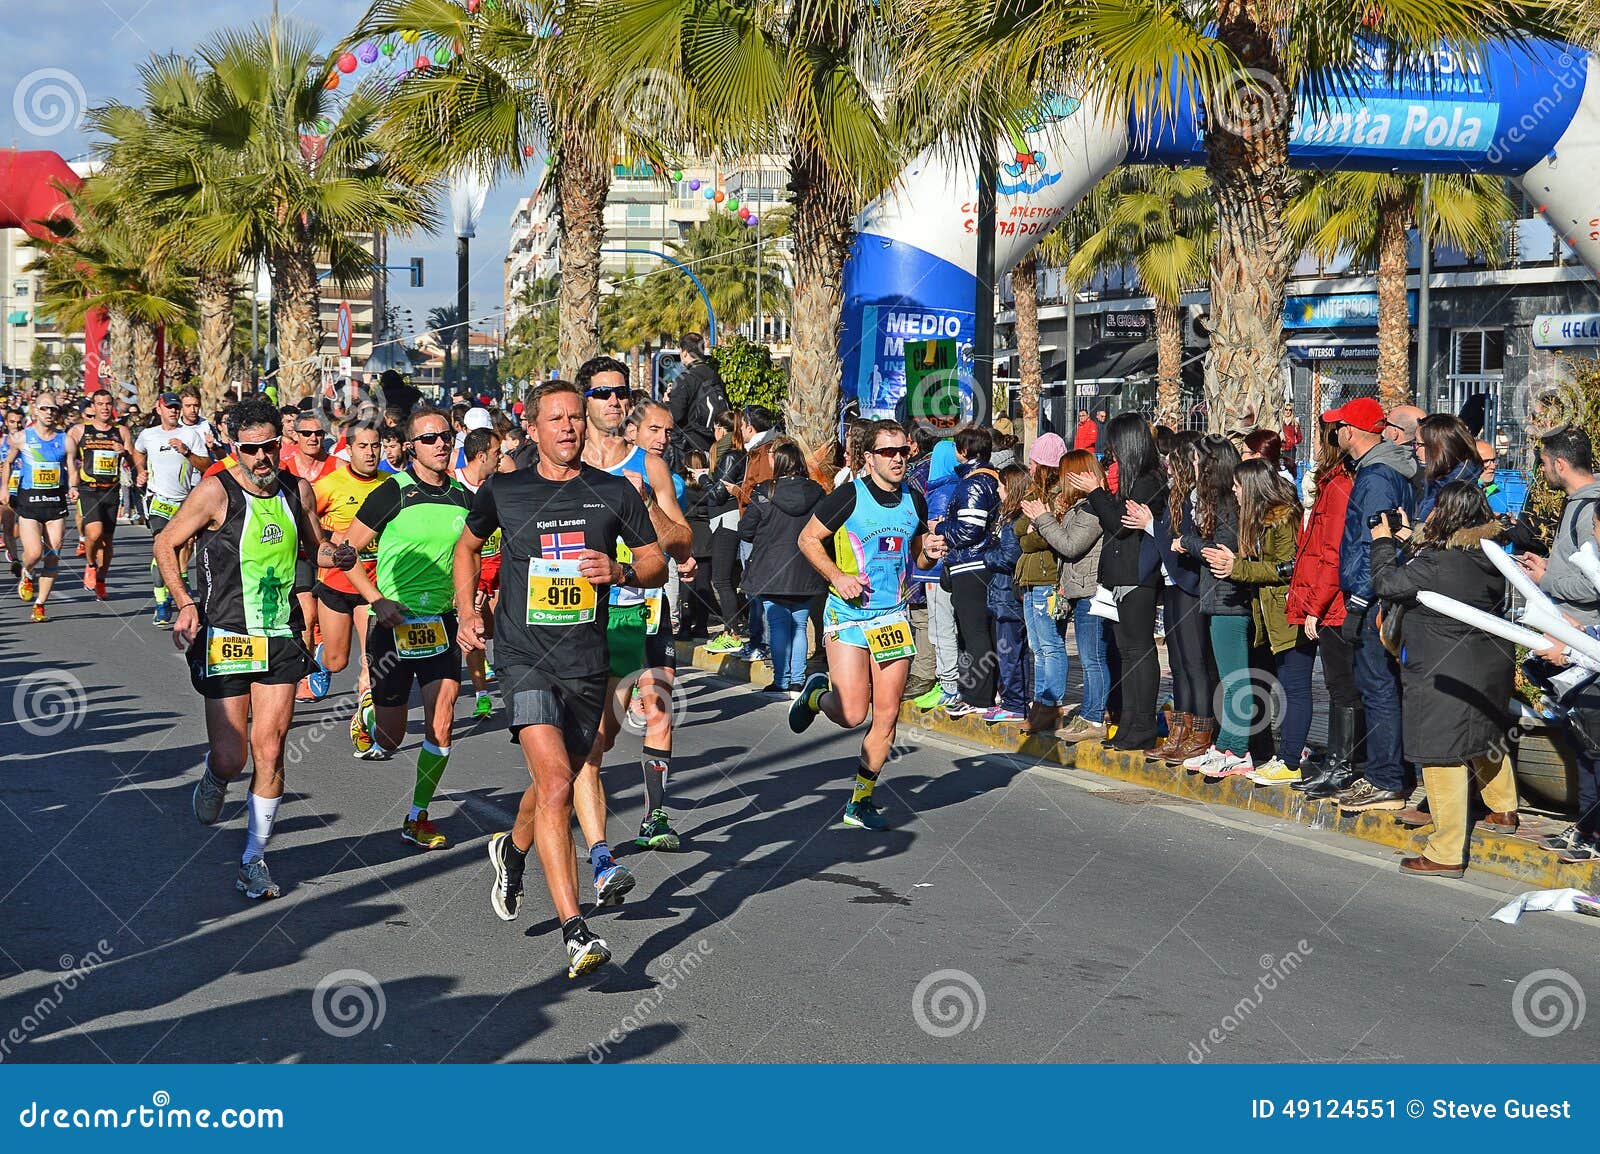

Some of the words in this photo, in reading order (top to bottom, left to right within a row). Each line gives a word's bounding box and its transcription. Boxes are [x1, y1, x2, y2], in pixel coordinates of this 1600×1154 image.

[1400, 104, 1482, 148] Pola
[1315, 297, 1378, 320] INTERSOL
[886, 312, 961, 338] MEDIO
[1561, 321, 1600, 338] HELA
[1308, 347, 1336, 358] INTERSOL
[1340, 347, 1379, 359] Apartamento
[536, 519, 557, 529] Kjetil
[558, 518, 586, 527] Larsen
[551, 577, 576, 586] KJETIL
[547, 586, 582, 606] 916
[408, 629, 436, 646] 938
[876, 629, 904, 648] 1319
[221, 643, 254, 658] 654
